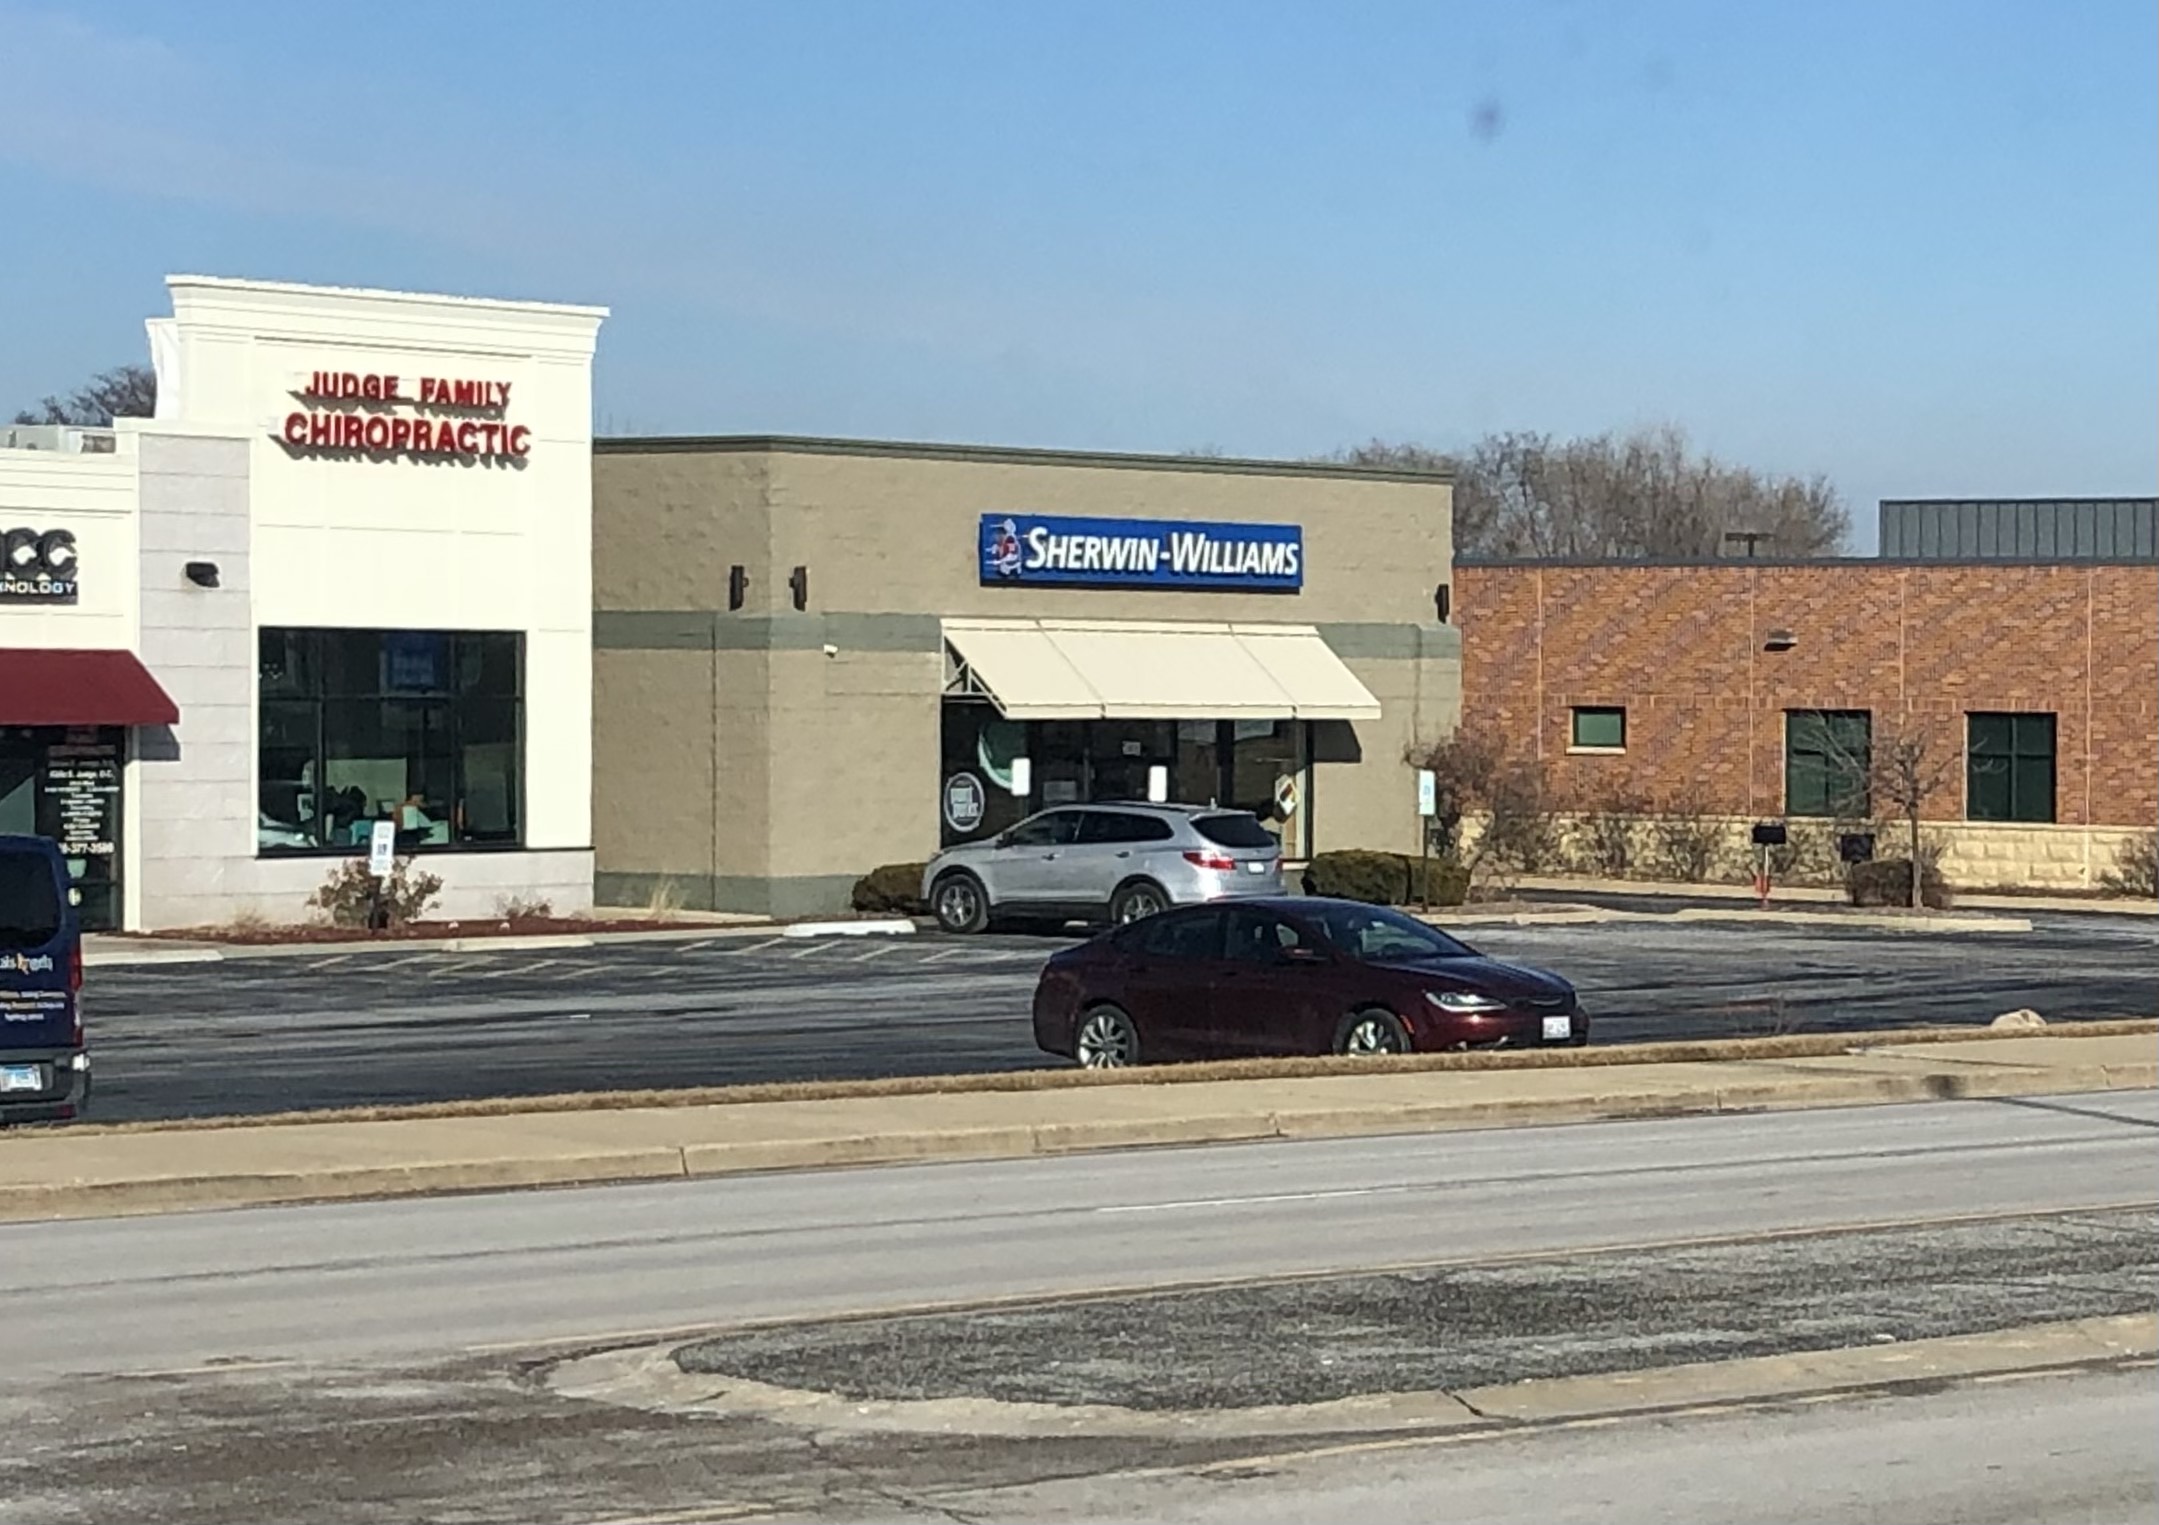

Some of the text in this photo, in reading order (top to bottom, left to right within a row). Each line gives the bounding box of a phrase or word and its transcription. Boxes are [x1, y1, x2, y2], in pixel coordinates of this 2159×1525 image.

[305, 371, 512, 407] JUDGE FAMILY
[285, 411, 532, 459] CHIROPRACTIC
[1026, 526, 1300, 577] SHERWIN-WILLIAMS
